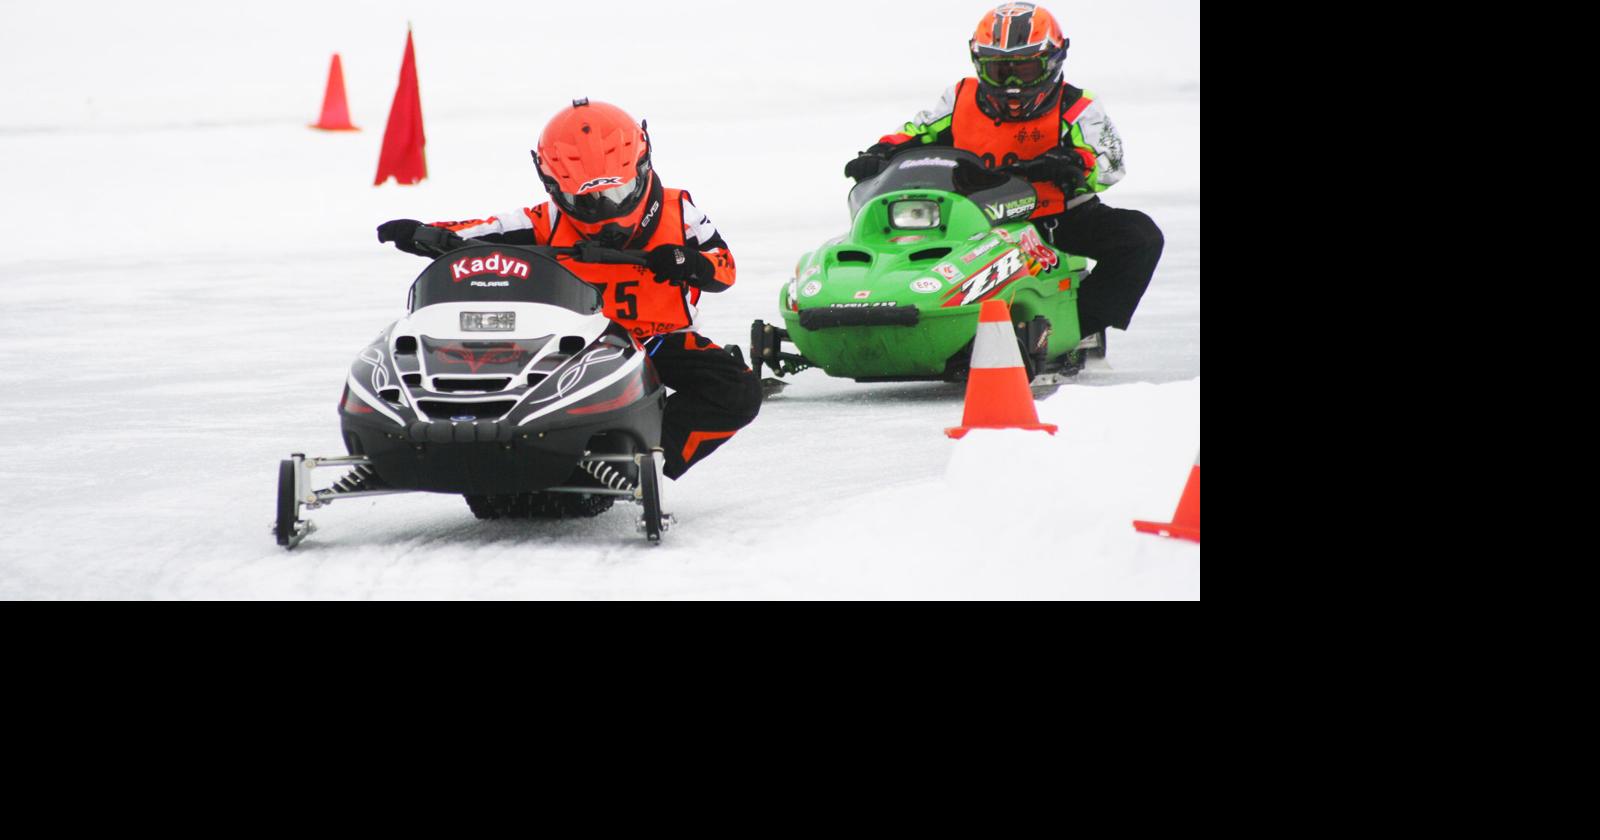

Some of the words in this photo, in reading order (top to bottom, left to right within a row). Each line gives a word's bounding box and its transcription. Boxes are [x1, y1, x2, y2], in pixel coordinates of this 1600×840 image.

[580, 177, 619, 191] AFX
[452, 254, 528, 278] Kadyn
[960, 248, 1024, 306] ZR
